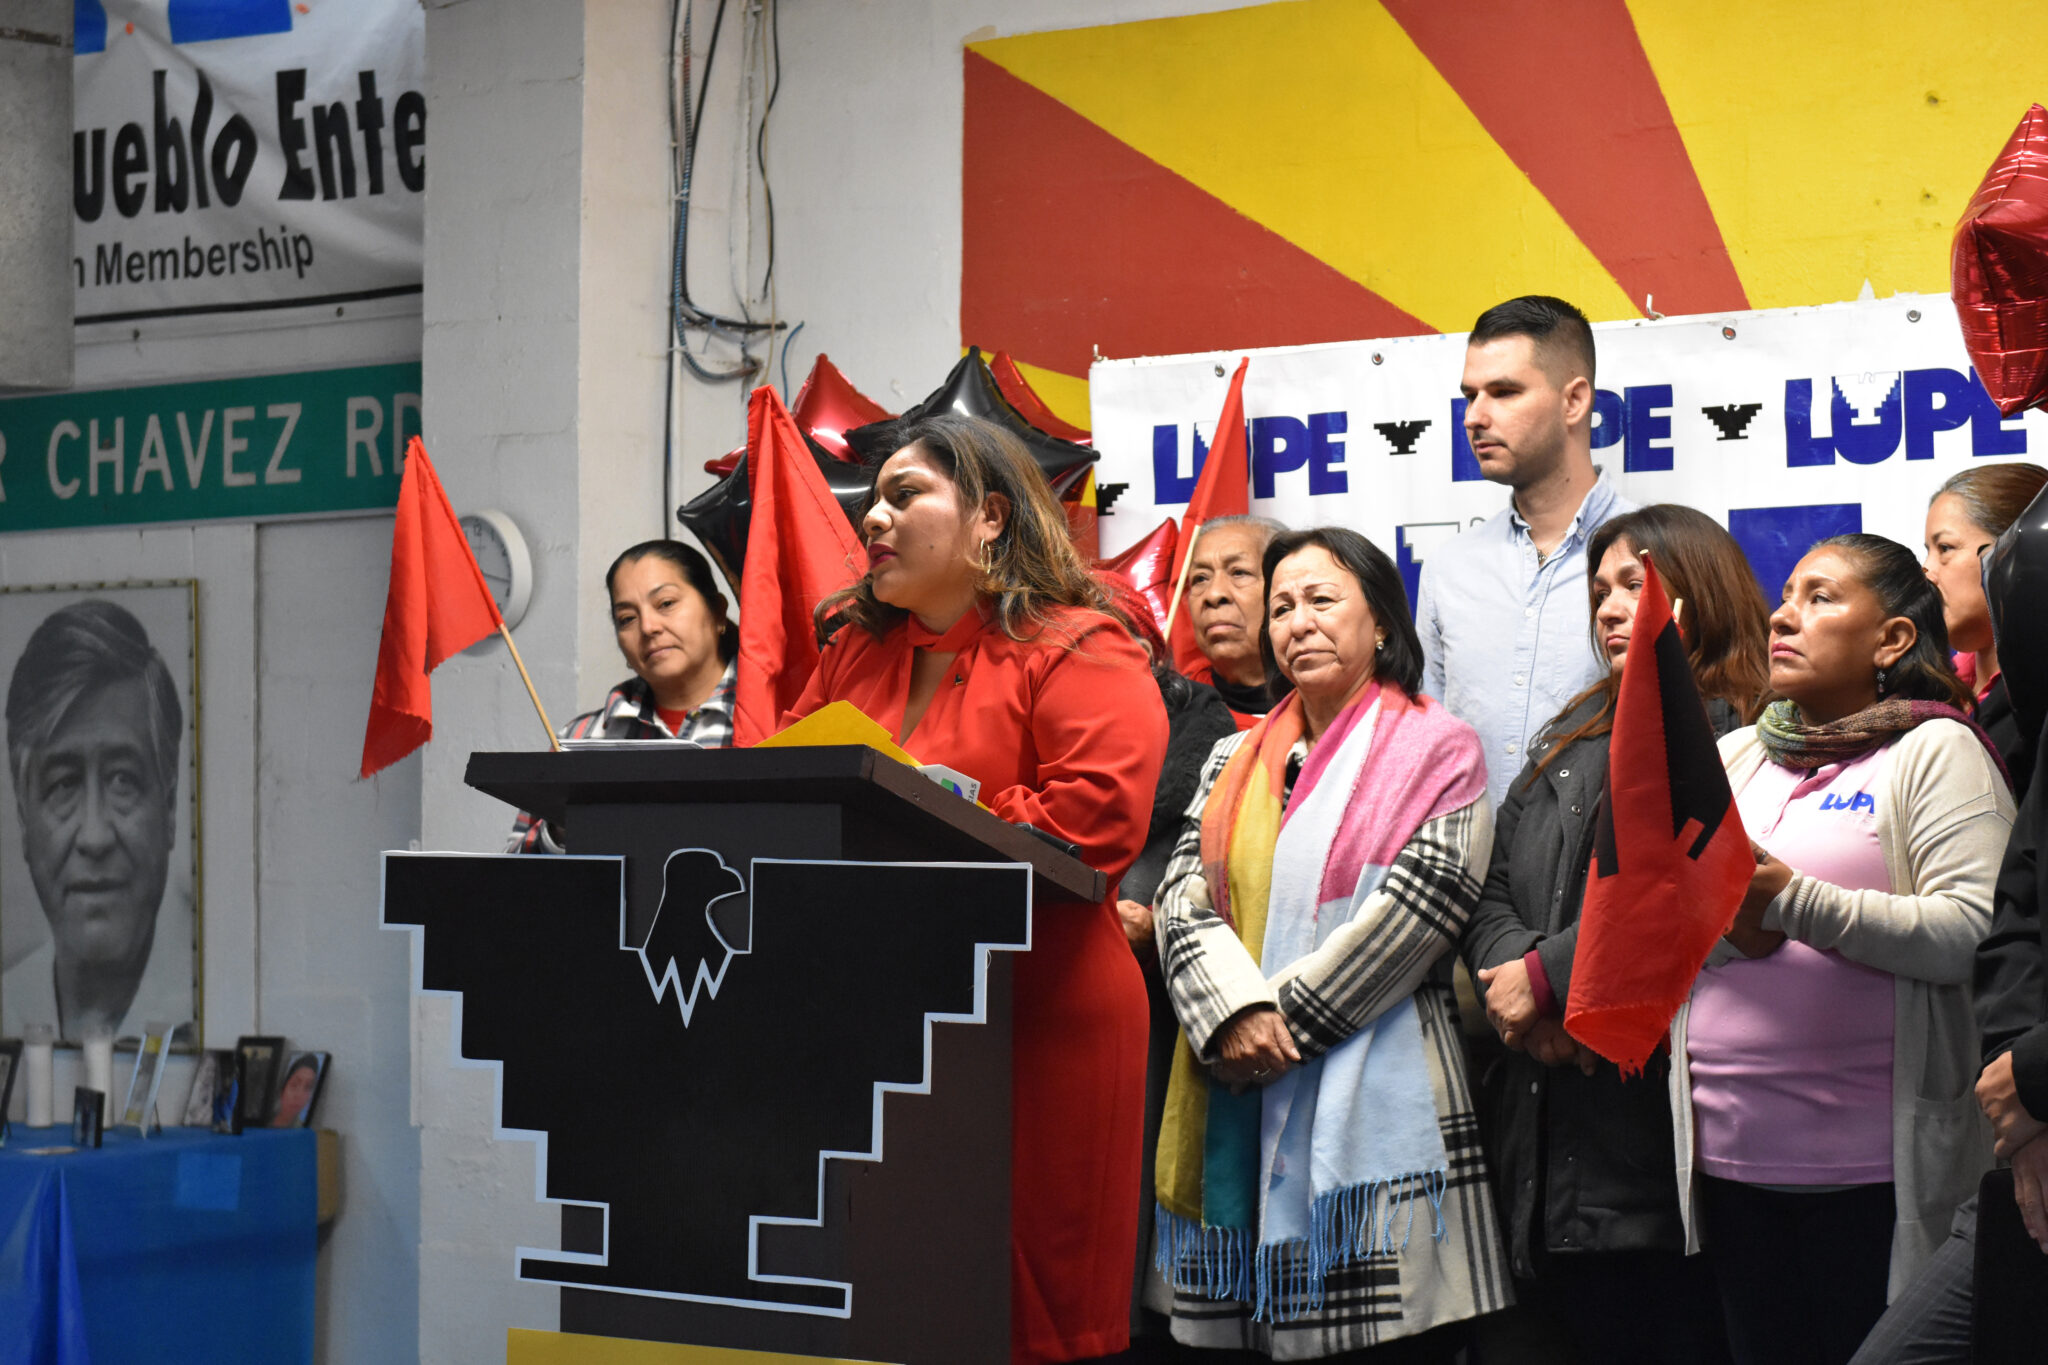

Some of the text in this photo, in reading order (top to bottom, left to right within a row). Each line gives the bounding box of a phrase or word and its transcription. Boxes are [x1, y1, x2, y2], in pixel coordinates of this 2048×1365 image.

[95, 224, 315, 288] Membership
[47, 402, 302, 500] CHAVEZ
[346, 392, 423, 478] RD
[1153, 411, 1349, 505] LPE
